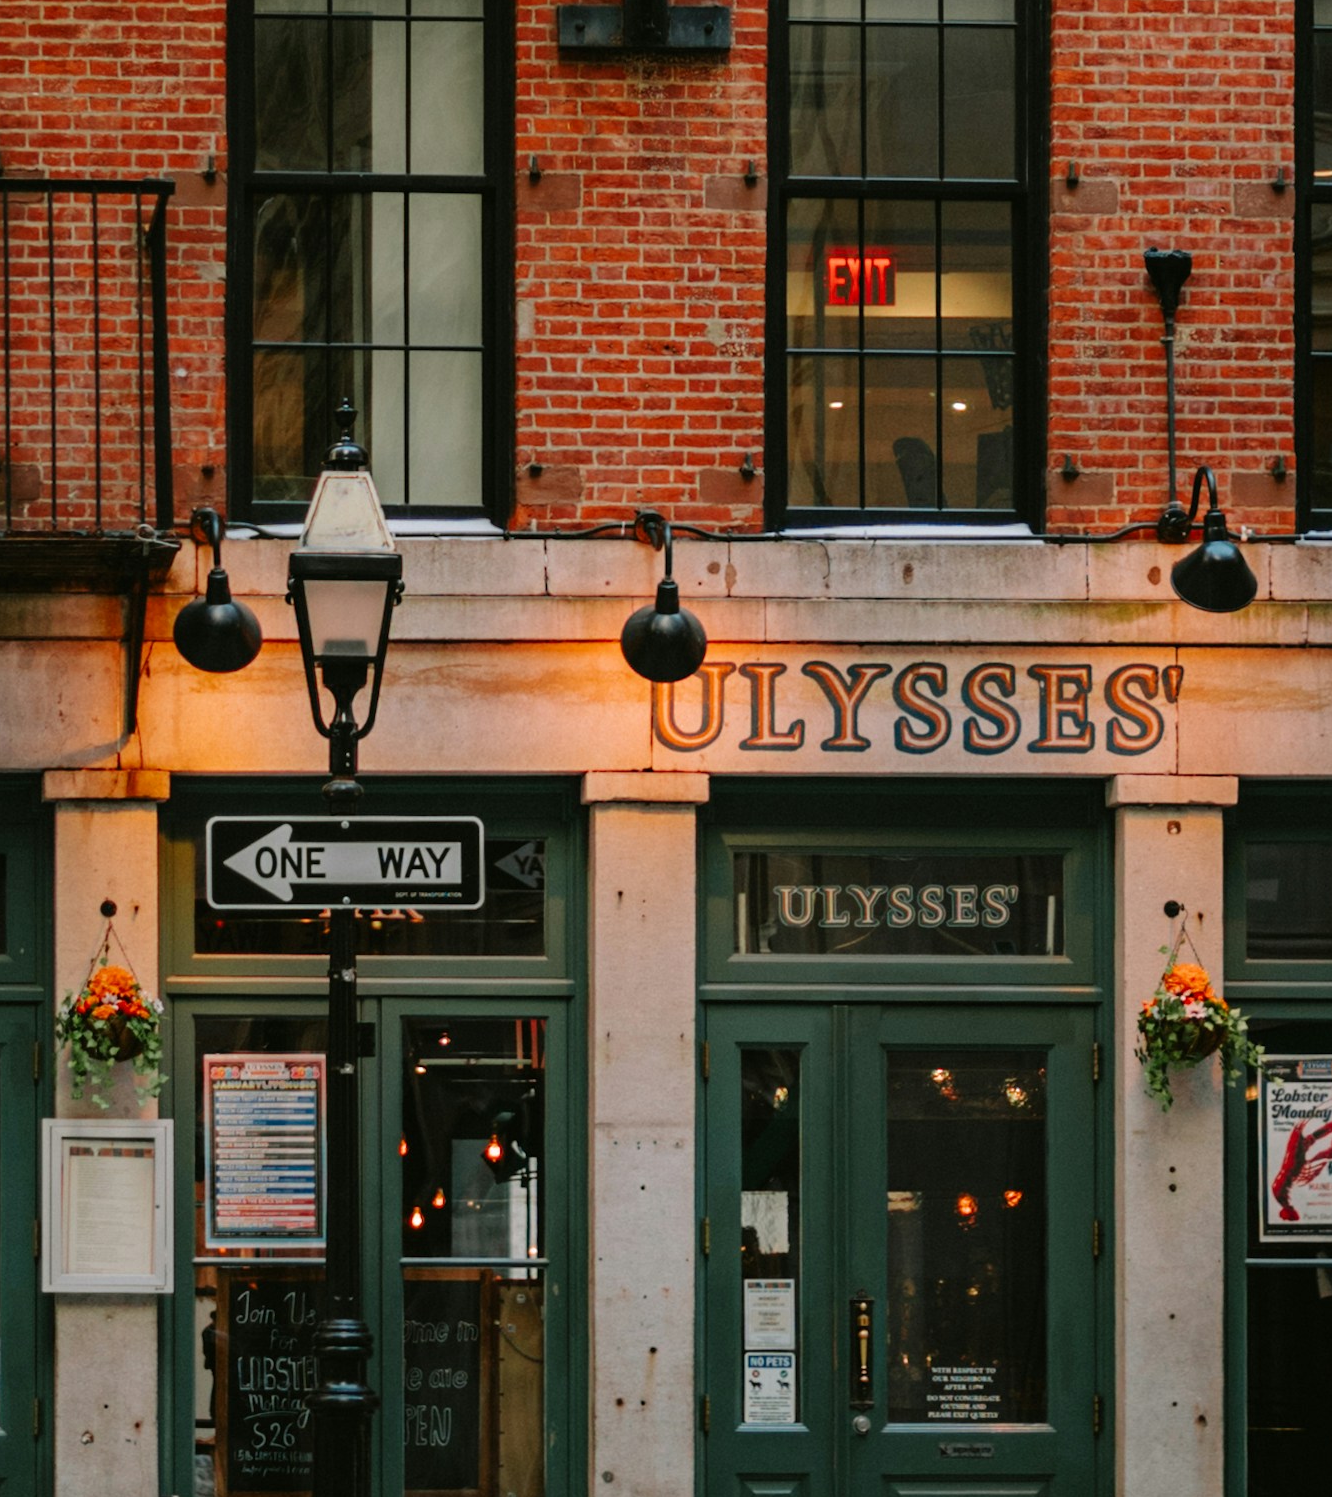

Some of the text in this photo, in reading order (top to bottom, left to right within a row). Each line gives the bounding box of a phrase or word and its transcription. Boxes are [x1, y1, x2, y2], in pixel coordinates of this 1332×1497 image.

[828, 257, 891, 305] EXIT
[654, 662, 1184, 755] ULYSSES'
[255, 847, 451, 879] ONE WAY
[774, 885, 1019, 928] ULYSSES'
[1271, 1088, 1328, 1103] Lobster
[1271, 1105, 1332, 1122] Monday
[236, 1291, 276, 1325] Join
[749, 1357, 790, 1367] NO PETS
[405, 1405, 452, 1446] PEN
